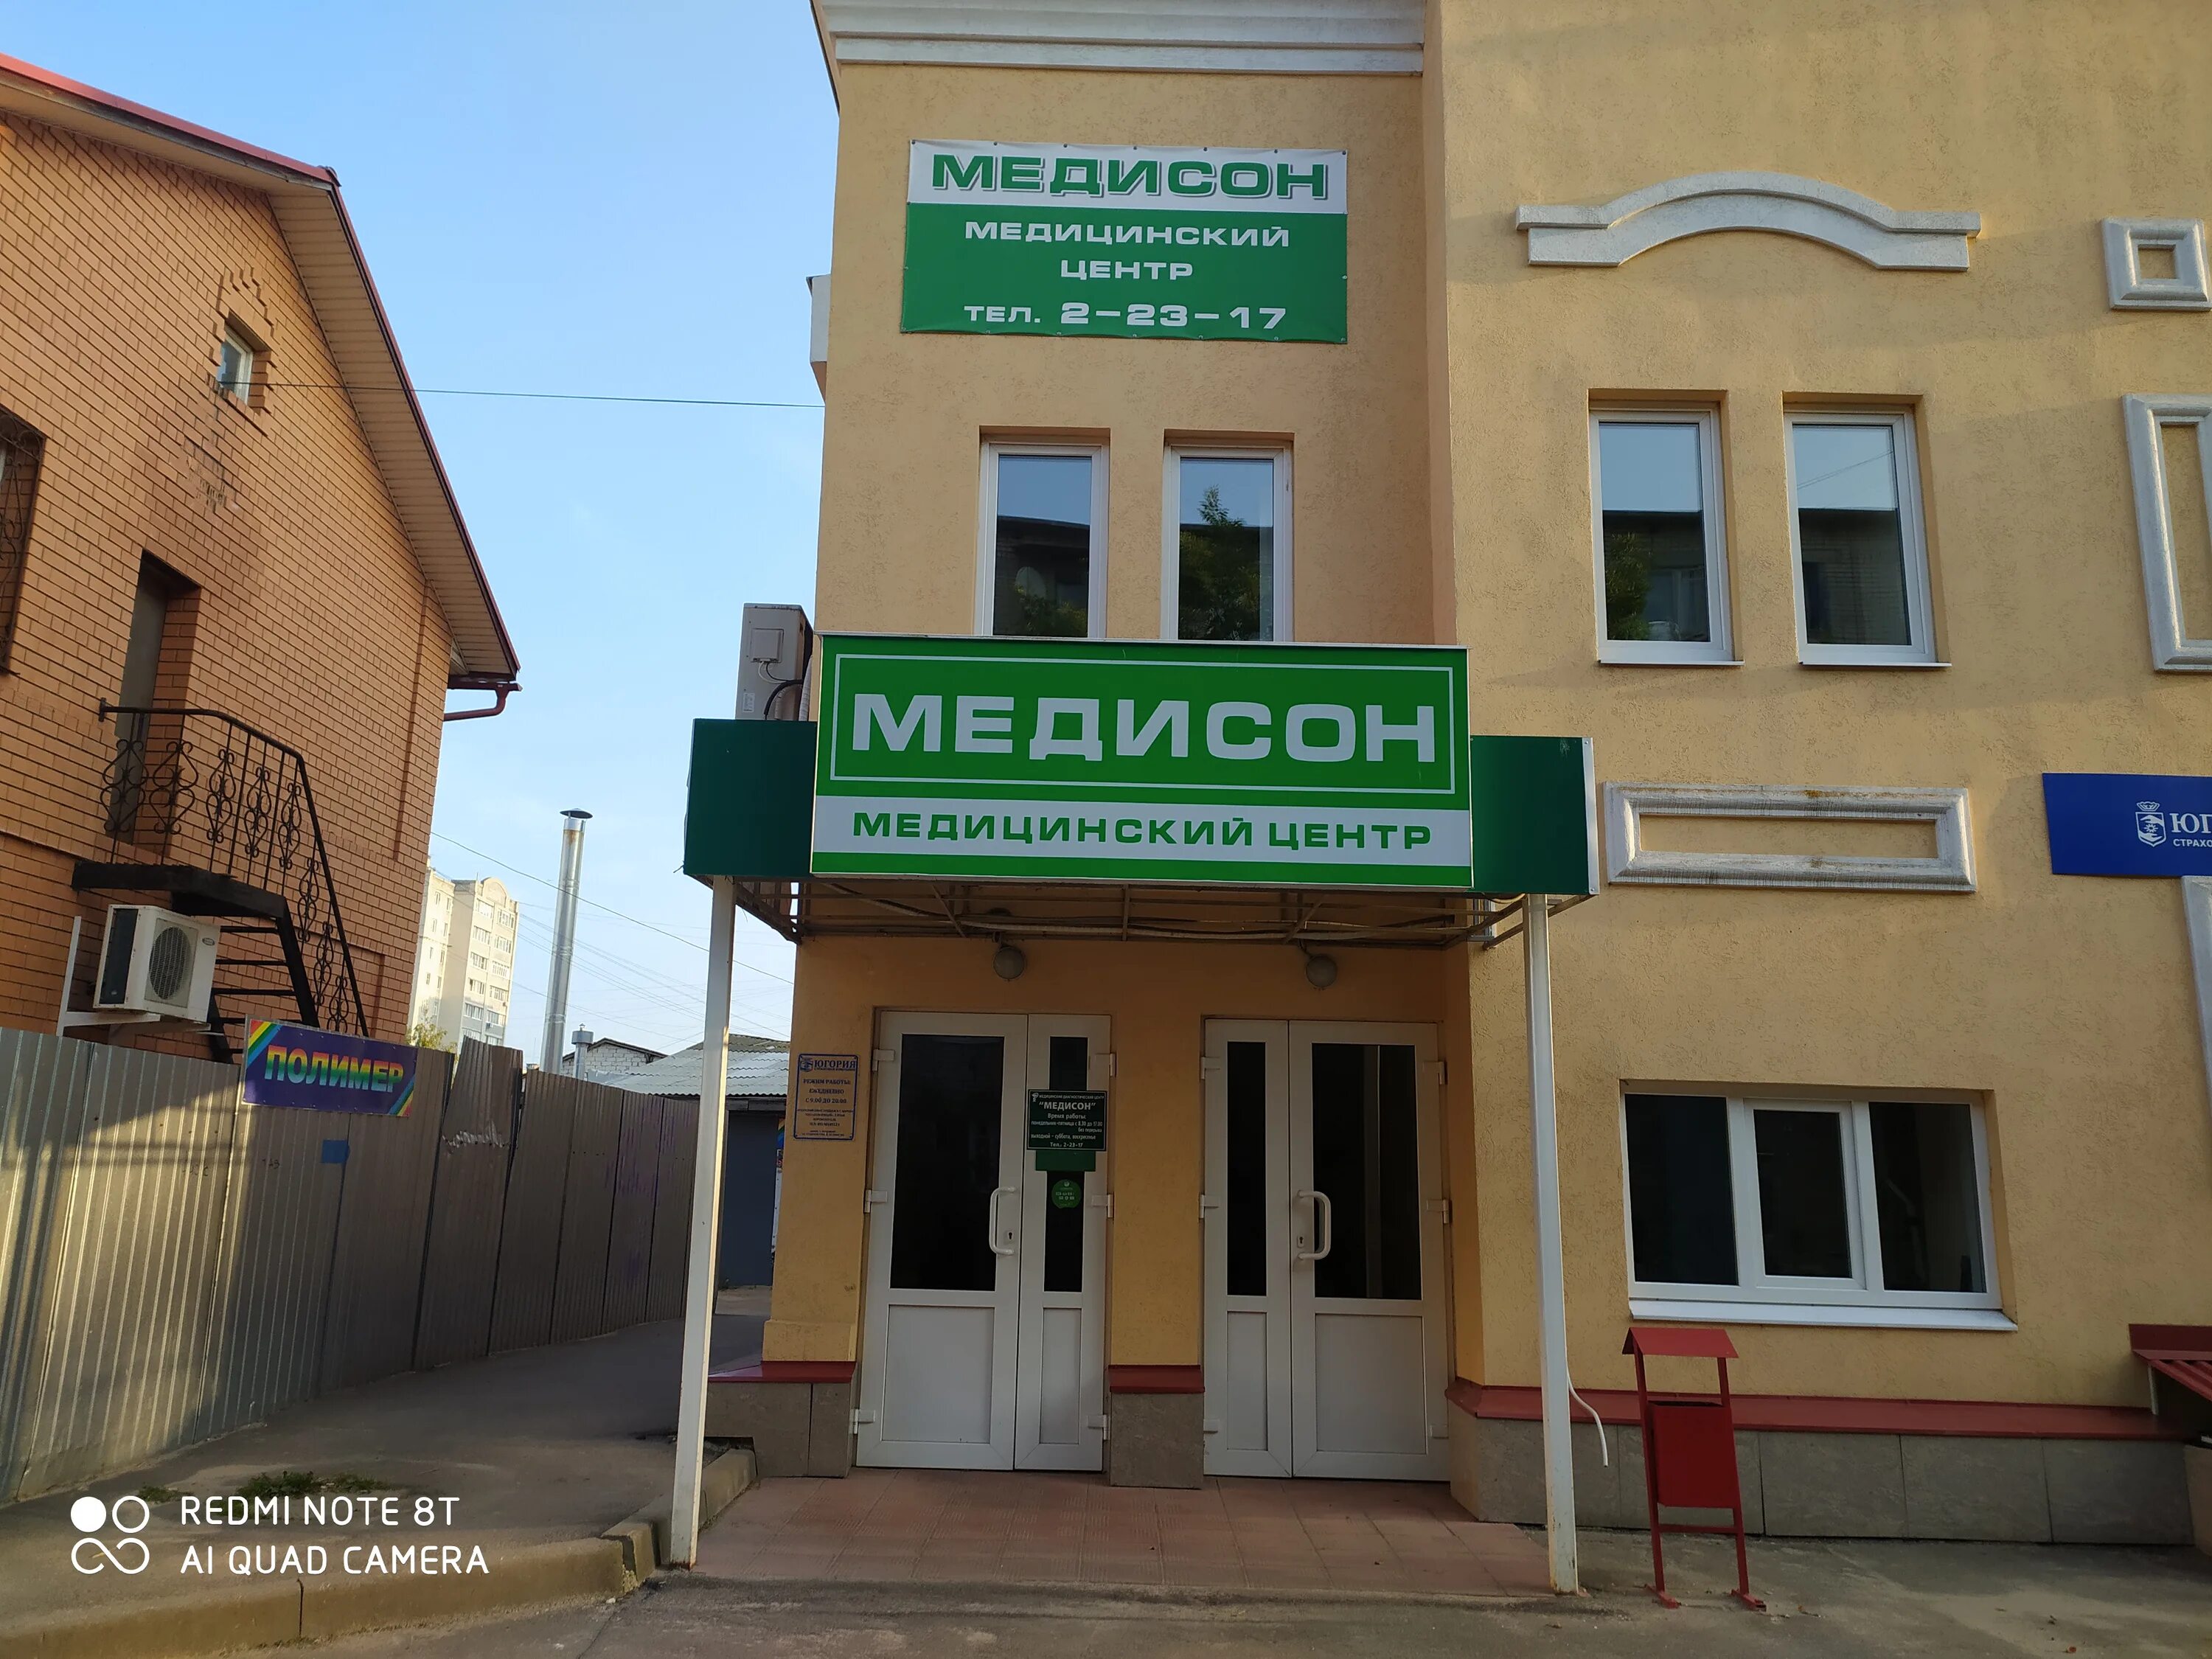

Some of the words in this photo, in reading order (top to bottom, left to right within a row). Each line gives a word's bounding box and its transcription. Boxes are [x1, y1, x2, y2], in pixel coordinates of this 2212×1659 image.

[931, 153, 1328, 200] МЕДИСОН
[964, 221, 1290, 247] МЕДИЦИНСКИЙ
[1060, 259, 1193, 281] ЦЕНТР
[964, 305, 1040, 324] ТЕЛ.
[852, 693, 1435, 763] МЕДИСОН
[852, 812, 1253, 847] МЕДИЦИНСКИЙ
[1268, 822, 1432, 852] ЦЕНТР
[264, 1045, 404, 1093] ПОЛИМЕР
[814, 1060, 856, 1068] ЮГОРИЯ
